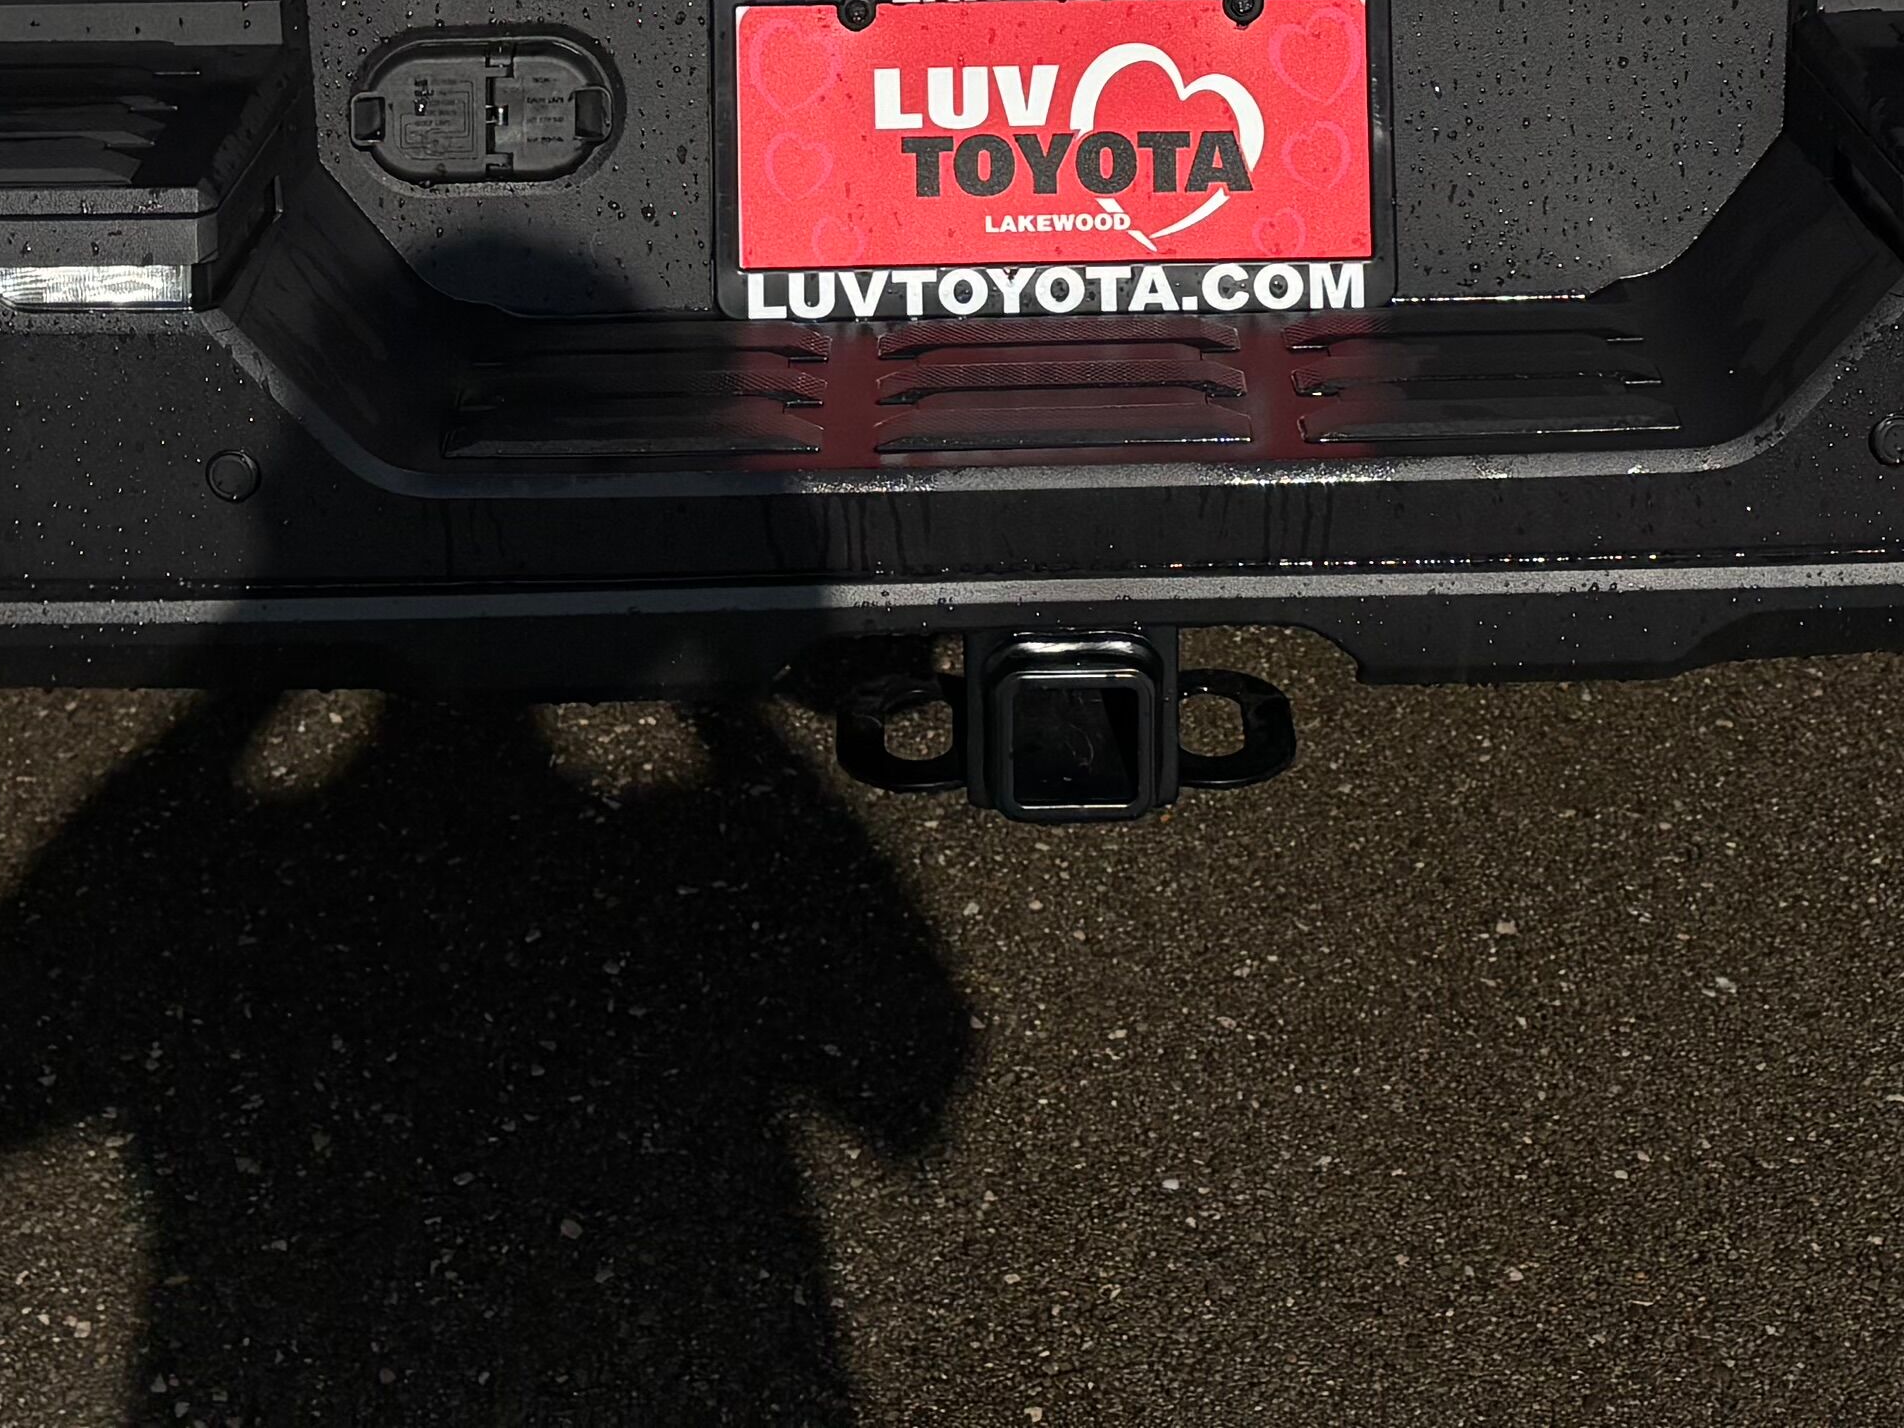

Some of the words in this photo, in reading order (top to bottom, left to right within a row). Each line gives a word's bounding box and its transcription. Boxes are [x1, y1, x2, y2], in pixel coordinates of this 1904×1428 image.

[873, 64, 1059, 130] LUV
[901, 130, 1254, 198] TOYOTA
[985, 212, 1131, 233] LAKEWOOD
[747, 262, 1366, 319] LUVTOYOTA.COM
